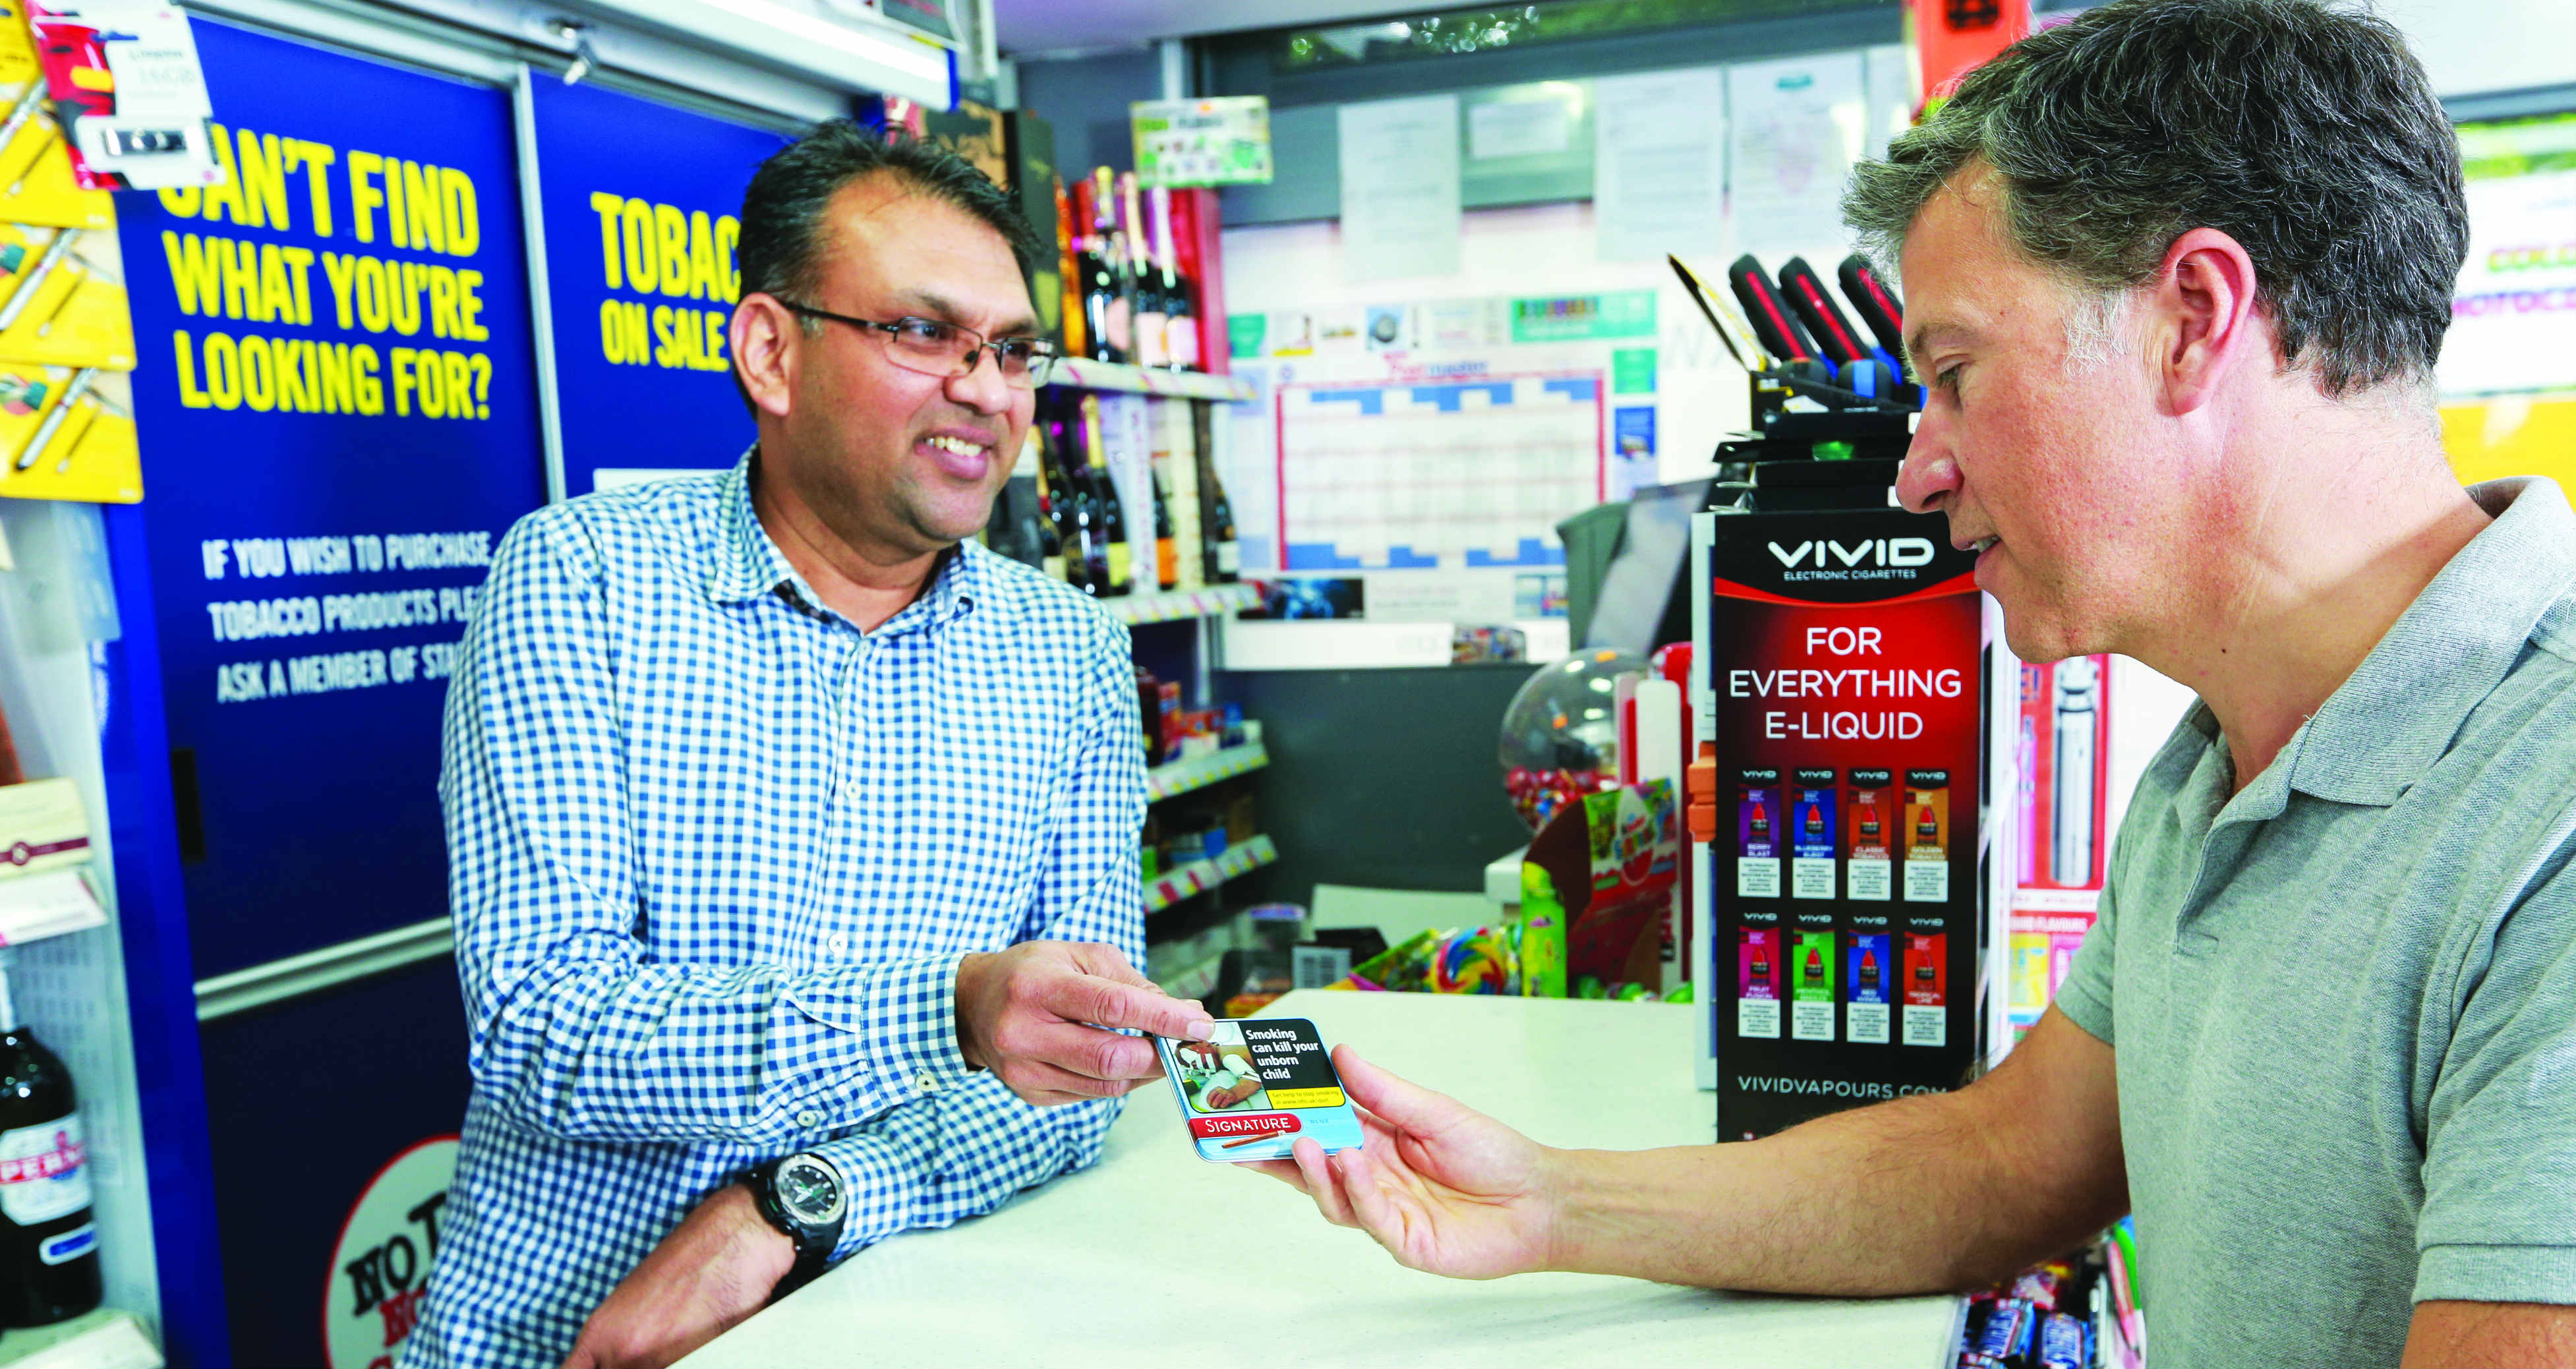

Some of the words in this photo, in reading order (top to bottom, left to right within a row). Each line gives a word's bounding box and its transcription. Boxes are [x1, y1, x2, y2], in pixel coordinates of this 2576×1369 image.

[347, 150, 479, 256] FIND
[591, 190, 741, 305] TOBAC
[162, 230, 314, 326] WHAT
[322, 250, 490, 343] YOU'RE
[600, 299, 650, 366] ON
[653, 305, 730, 372] SALE
[173, 330, 385, 416] LOOKING
[390, 347, 492, 421] FOR?
[201, 539, 229, 579] IF
[231, 537, 286, 578] YOU
[286, 535, 353, 576] WISH
[352, 534, 384, 572] TO
[384, 531, 492, 571] PURCHASE
[1768, 537, 1935, 568] VIVID
[1783, 570, 1849, 581] ELECTRONIC
[1851, 569, 1917, 580] CIGARETTES
[206, 596, 321, 642] TOBACCO
[322, 588, 438, 633] PRODUCTS
[1806, 626, 1883, 656] FOR
[216, 661, 266, 704] ASK
[268, 658, 288, 698] A
[287, 649, 388, 696] MEMBER
[389, 645, 418, 684] OF
[1730, 668, 1962, 699] EVERYTHING
[1765, 711, 1923, 740] E-LIQUID
[1742, 770, 1777, 778] VIVID
[1799, 770, 1833, 779] VIVID
[1854, 771, 1889, 780] VIVID
[1911, 771, 1947, 780] VIVID
[1744, 912, 1777, 921] VIVID
[1798, 914, 1832, 923] VIVID
[1854, 916, 1887, 925] VIVID
[1245, 1028, 1297, 1041] Smoking
[1252, 1044, 1273, 1053] can
[1272, 1041, 1293, 1052] kill
[1292, 1043, 1319, 1054] your
[1257, 1055, 1299, 1066] unborn
[1262, 1067, 1291, 1080] child
[1738, 1076, 1947, 1099] VIVIDVAPOURSCO
[1205, 1117, 1291, 1133] SIGNATURE
